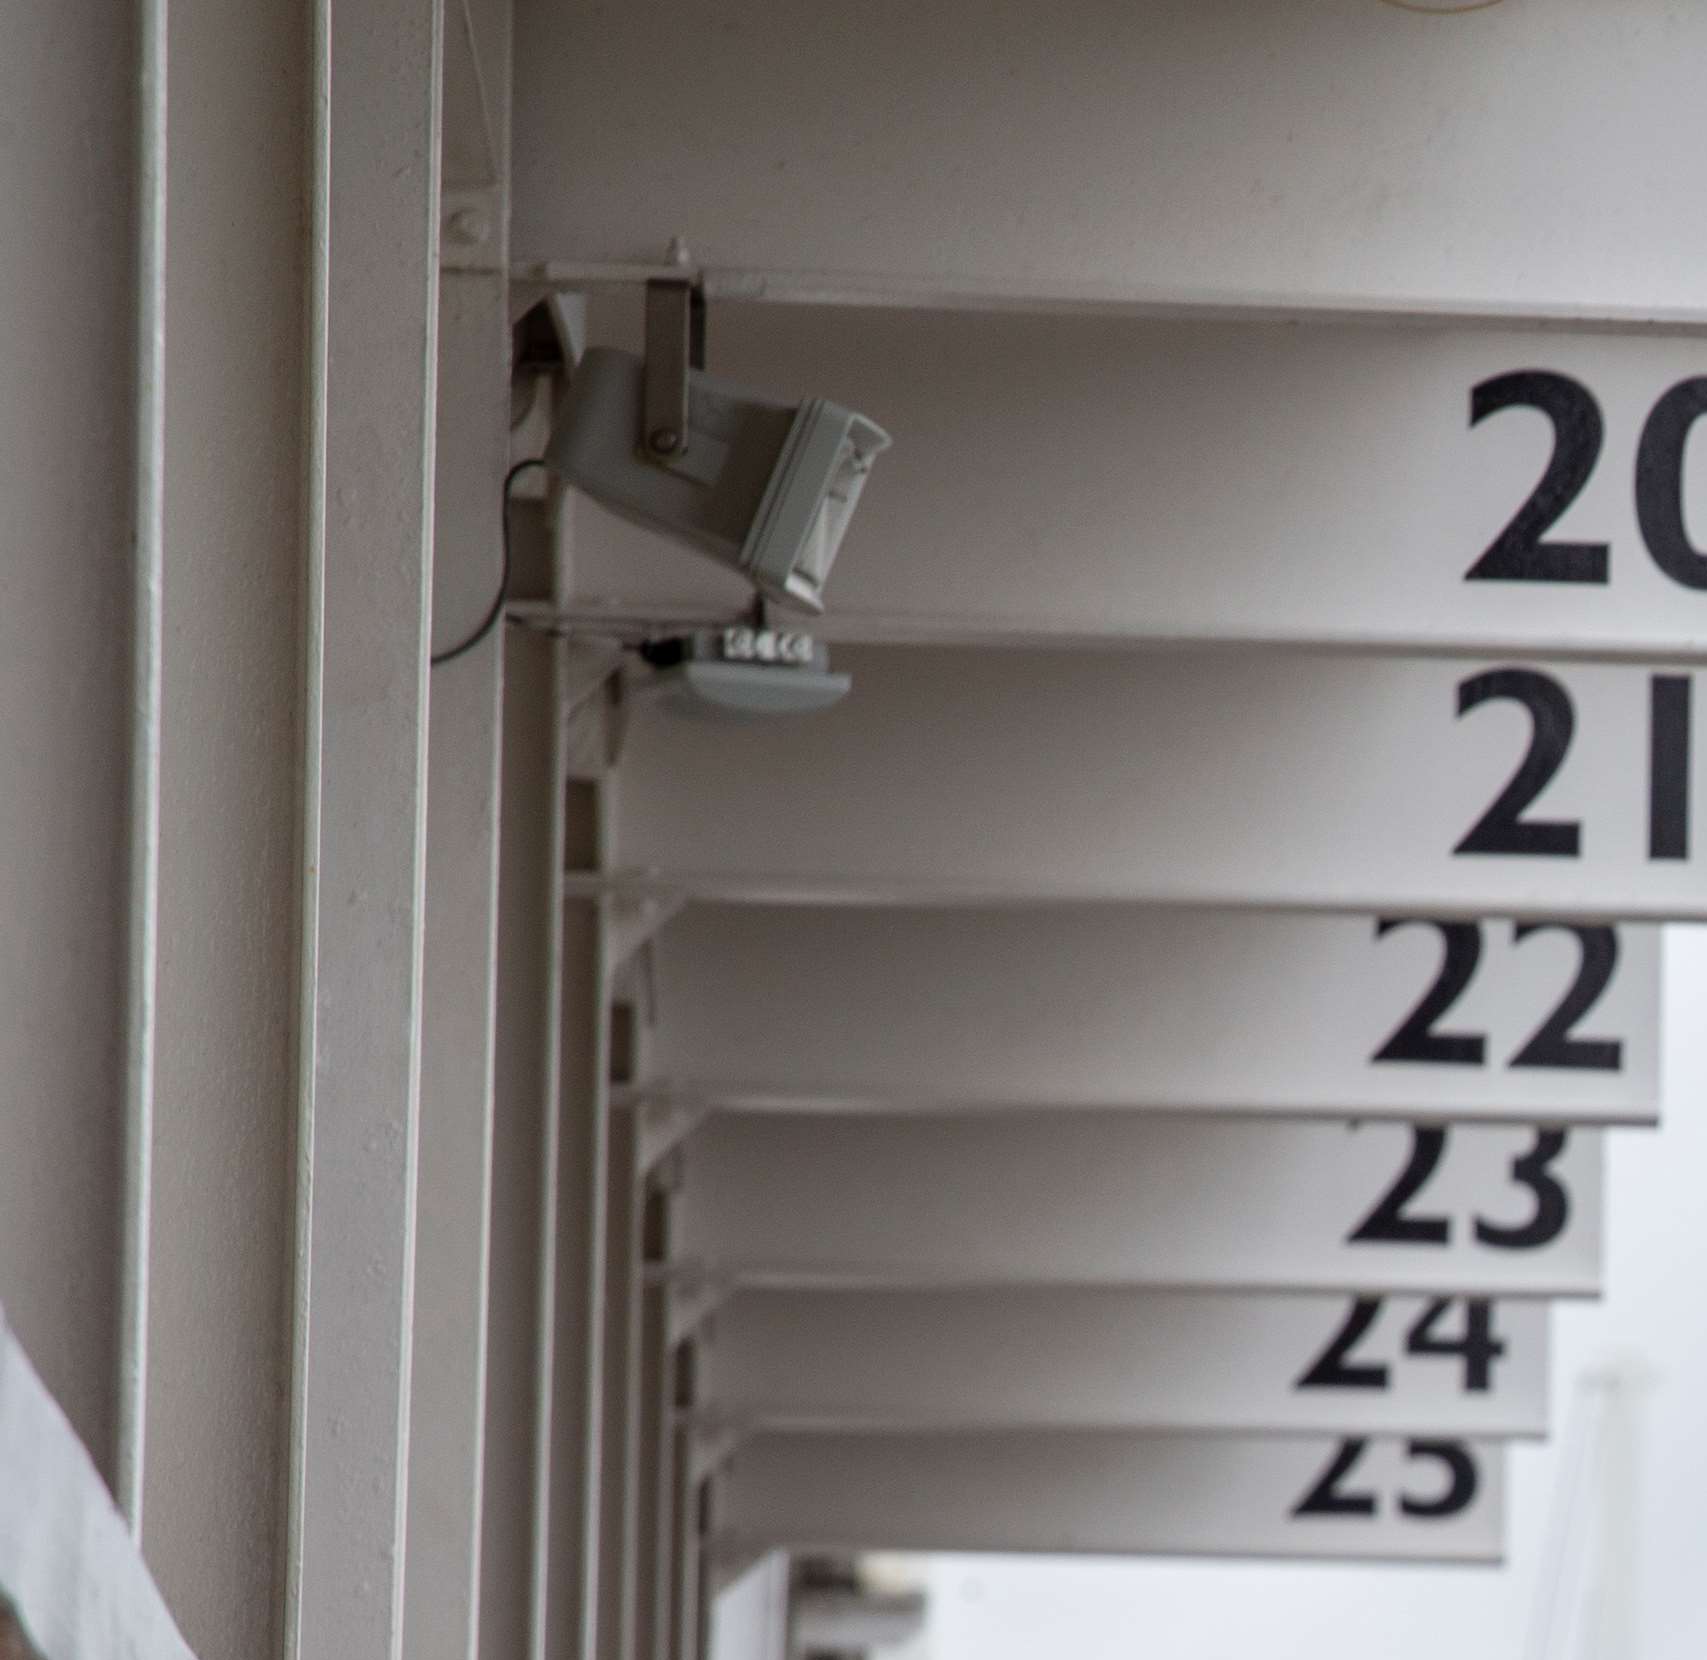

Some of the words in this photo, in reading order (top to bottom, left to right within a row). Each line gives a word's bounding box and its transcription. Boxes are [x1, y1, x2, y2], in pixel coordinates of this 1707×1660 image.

[1451, 666, 1693, 862] 21
[1369, 919, 1623, 1073] 22
[1344, 1122, 1572, 1252] 23
[1293, 1297, 1506, 1393] 24
